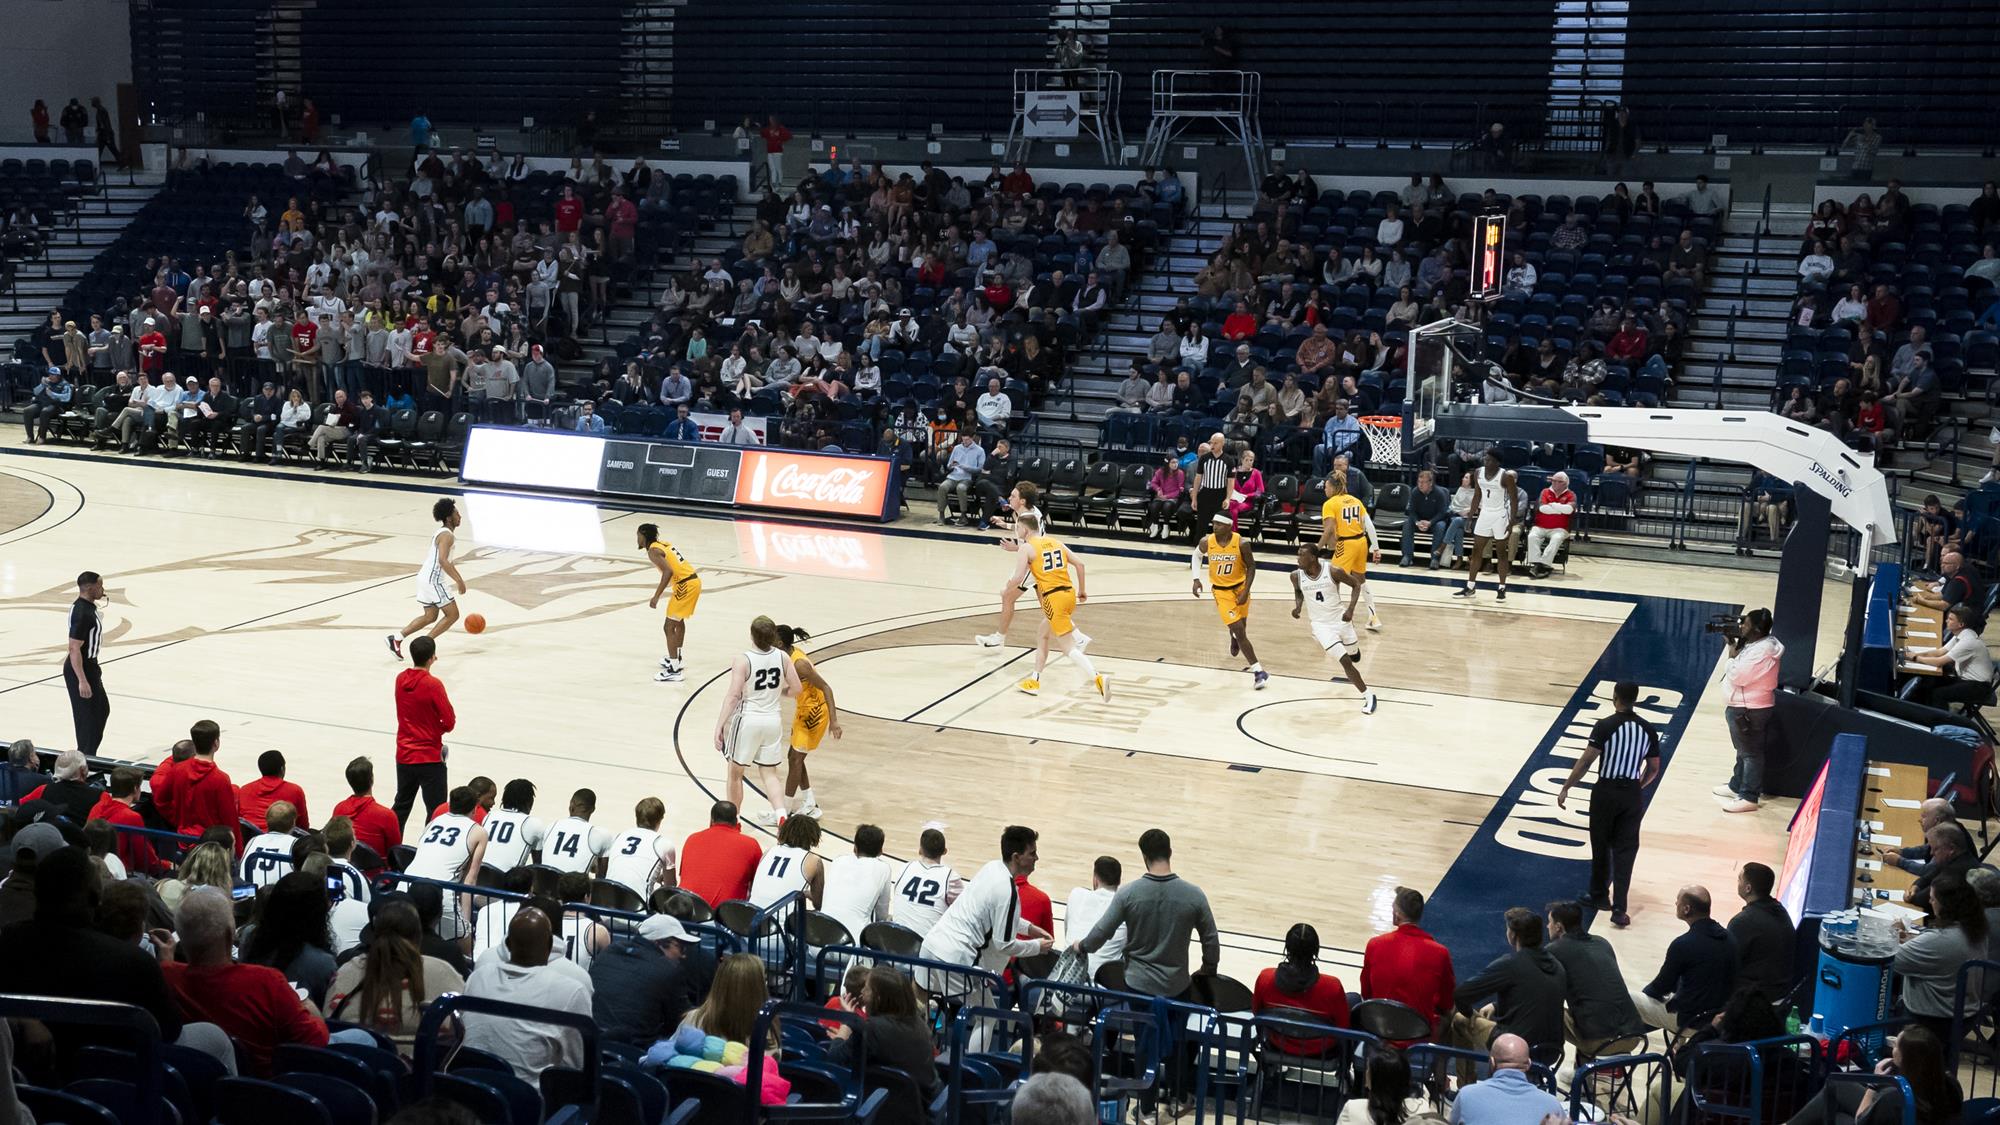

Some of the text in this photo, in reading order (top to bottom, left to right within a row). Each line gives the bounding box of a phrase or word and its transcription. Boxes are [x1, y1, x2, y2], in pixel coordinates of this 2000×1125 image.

[606, 460, 634, 470] SAMFORD
[658, 467, 678, 476] PERIOD
[706, 468, 729, 478] GUEST
[771, 464, 874, 504] Coca-Cola
[1809, 462, 1852, 498] SPALDING
[1342, 506, 1360, 524] 44
[1042, 550, 1063, 571] 33
[1216, 564, 1233, 575] 10
[1316, 591, 1325, 602] 4
[755, 667, 781, 691] 23
[424, 825, 460, 847] 33
[488, 819, 514, 843] 10
[553, 831, 580, 857] 14
[621, 836, 641, 855] 3
[768, 856, 790, 878] 11
[903, 876, 940, 906] 42
